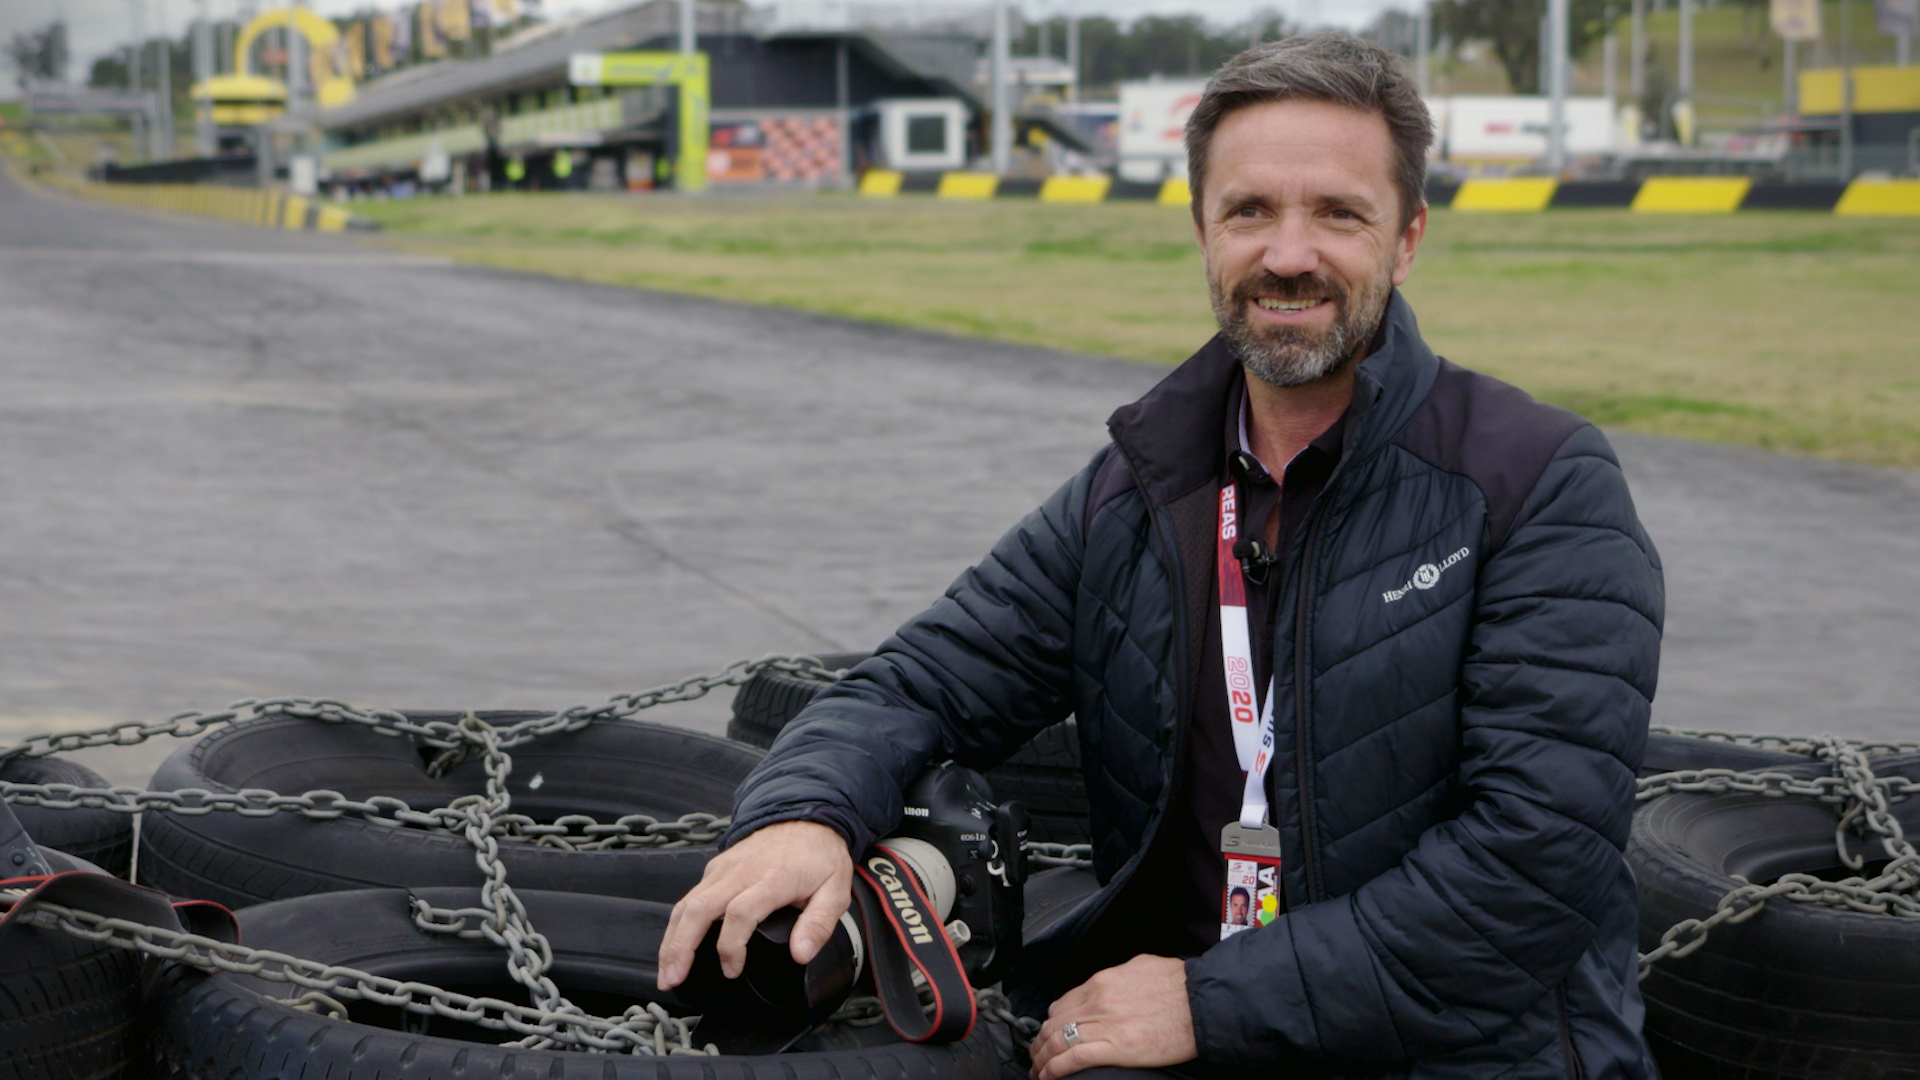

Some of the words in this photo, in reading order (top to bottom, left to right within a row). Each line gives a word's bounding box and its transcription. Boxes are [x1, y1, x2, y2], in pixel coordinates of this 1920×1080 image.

[1438, 546, 1470, 573] LLOYD
[1226, 655, 1254, 724] 2020
[867, 856, 934, 945] Canon
[1242, 875, 1255, 885] 20
